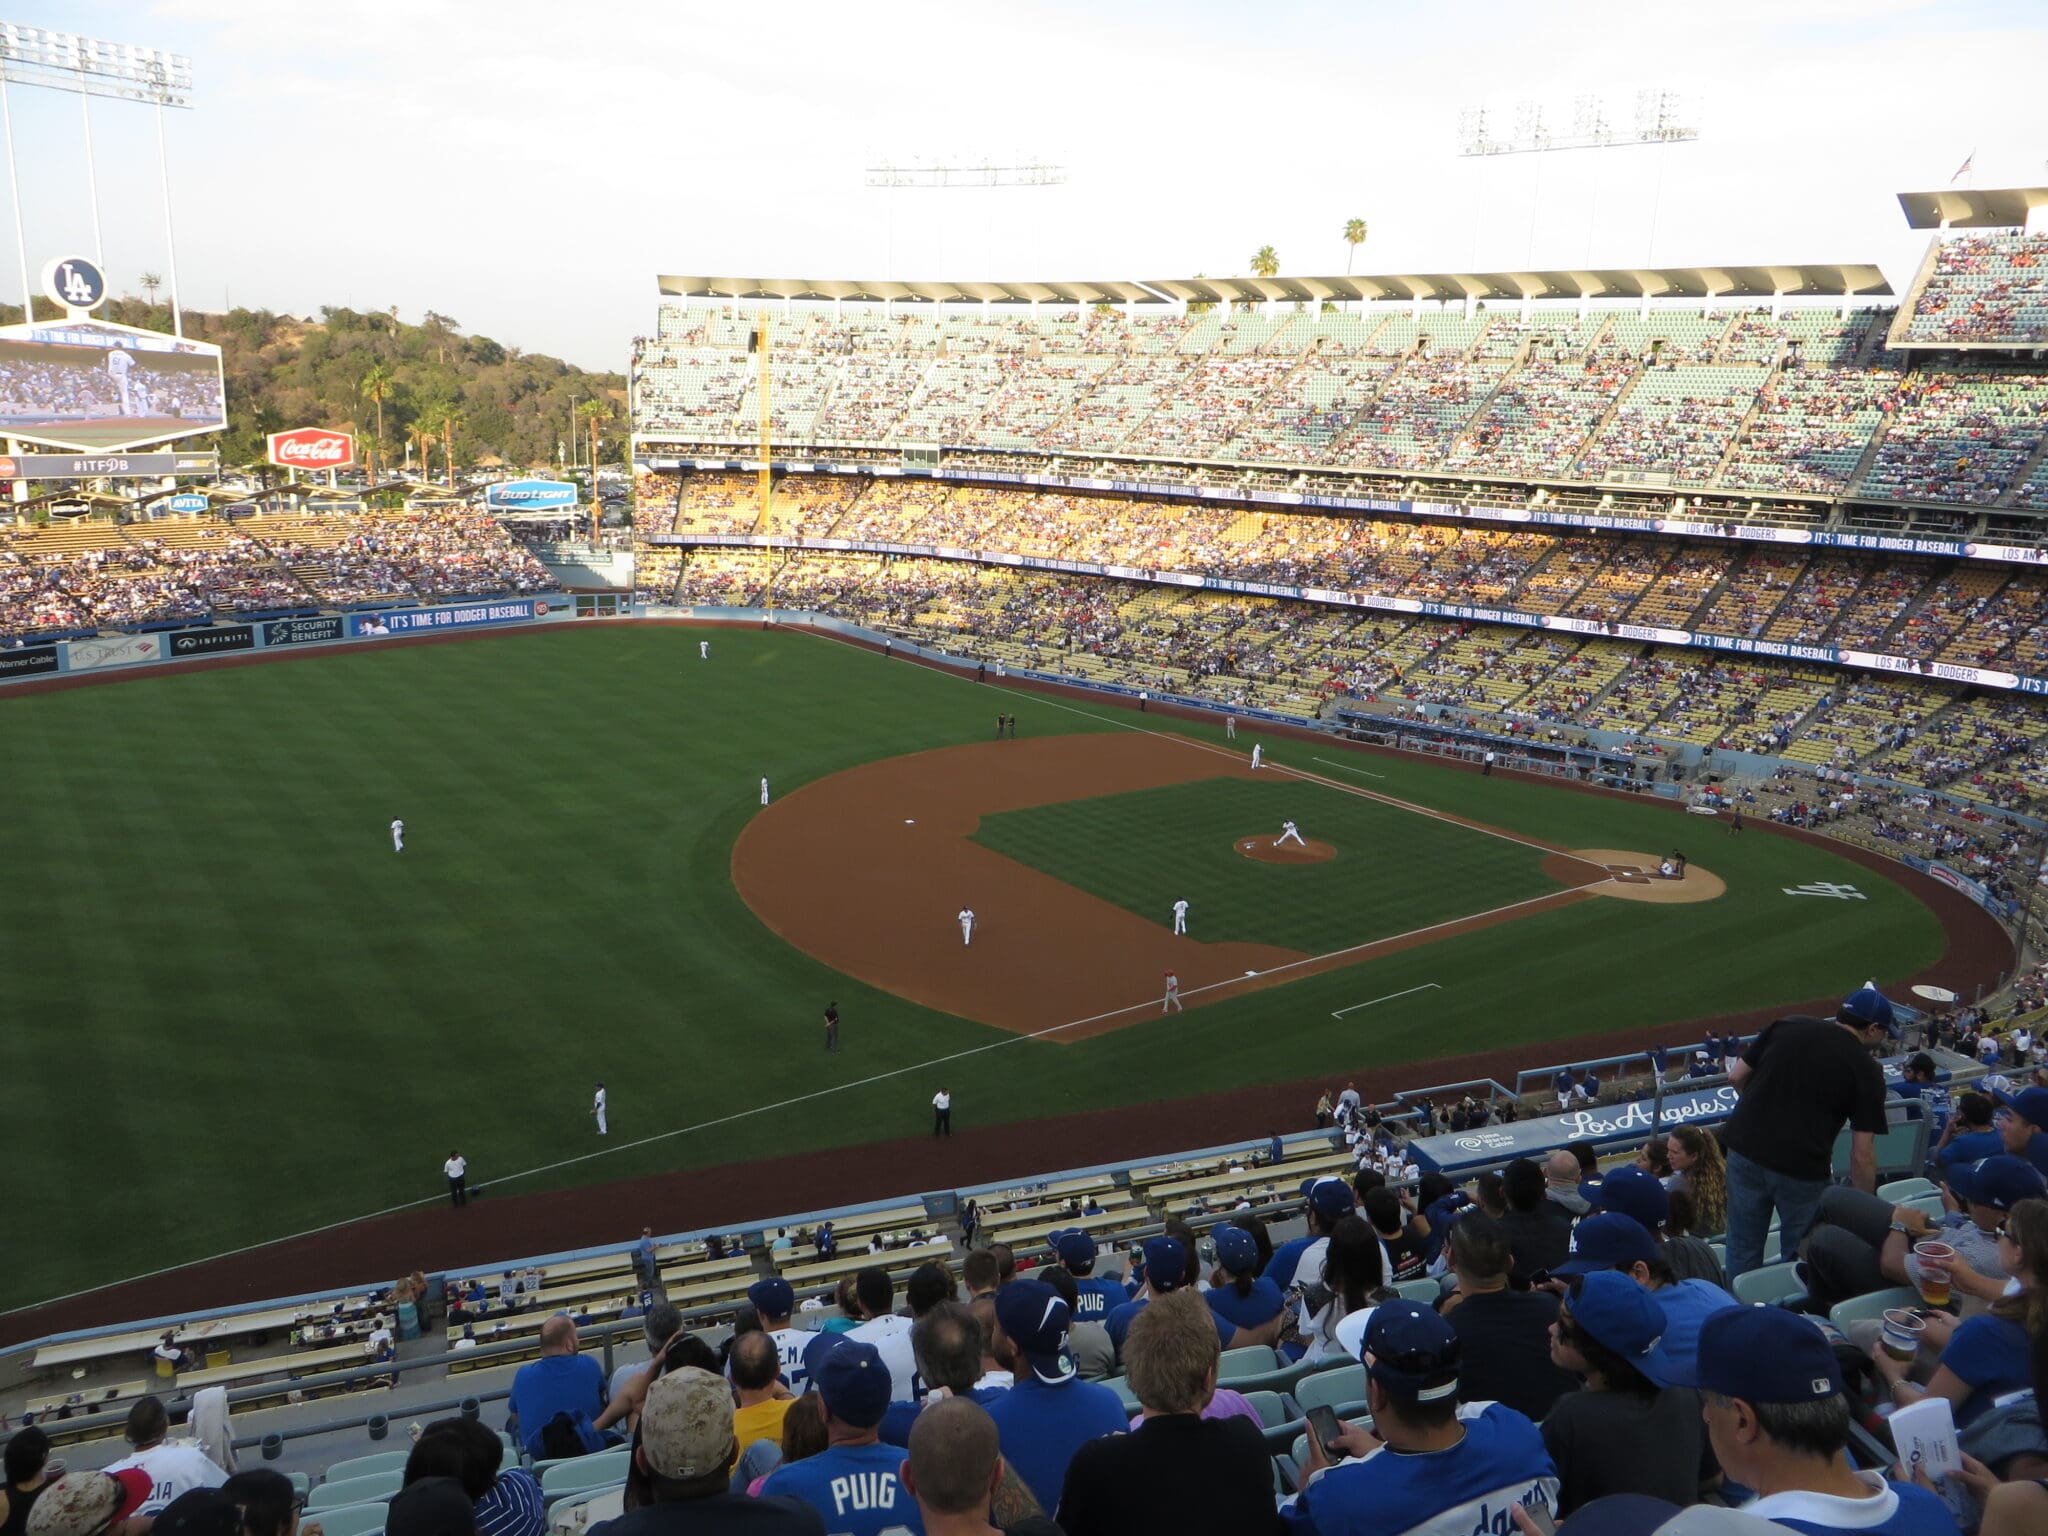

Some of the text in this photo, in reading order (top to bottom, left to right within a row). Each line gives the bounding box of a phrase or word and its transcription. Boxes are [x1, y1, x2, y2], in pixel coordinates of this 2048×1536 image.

[62, 263, 95, 302] LA
[1533, 512, 1547, 523] IT'S
[1549, 513, 1565, 524] TIME
[1568, 514, 1582, 525] FOR
[1739, 527, 1776, 540] DODGERS
[1837, 534, 1857, 546] TIME
[1860, 534, 1876, 547] FOR
[1879, 536, 1914, 550] DODGER
[1916, 541, 1960, 554] BASEBALL
[2002, 548, 2020, 559] LOS
[390, 615, 409, 629] IT'S
[410, 613, 433, 627] TIME
[435, 611, 452, 624] FOR
[454, 608, 487, 623] DODGER
[488, 605, 529, 620] BASEBALL
[1425, 602, 1538, 625] IT'S TIME FOR DODGER BASEBALL
[291, 620, 338, 632] SECURITY
[1570, 621, 1585, 631] LOS
[1622, 626, 1658, 639] DODGERS
[198, 634, 248, 645] INFINITI
[291, 631, 333, 641] BENEFIT
[1694, 634, 1833, 660] IT'S TIME FOR DODGER BASEBALL
[30, 655, 55, 665] Cable
[1874, 656, 1891, 667] LOS
[1937, 664, 1979, 681] DODGERS
[2022, 677, 2041, 691] IT'S
[1560, 1111, 1617, 1138] Los
[1077, 1293, 1104, 1313] PUIG
[830, 1472, 897, 1516] PUIG
